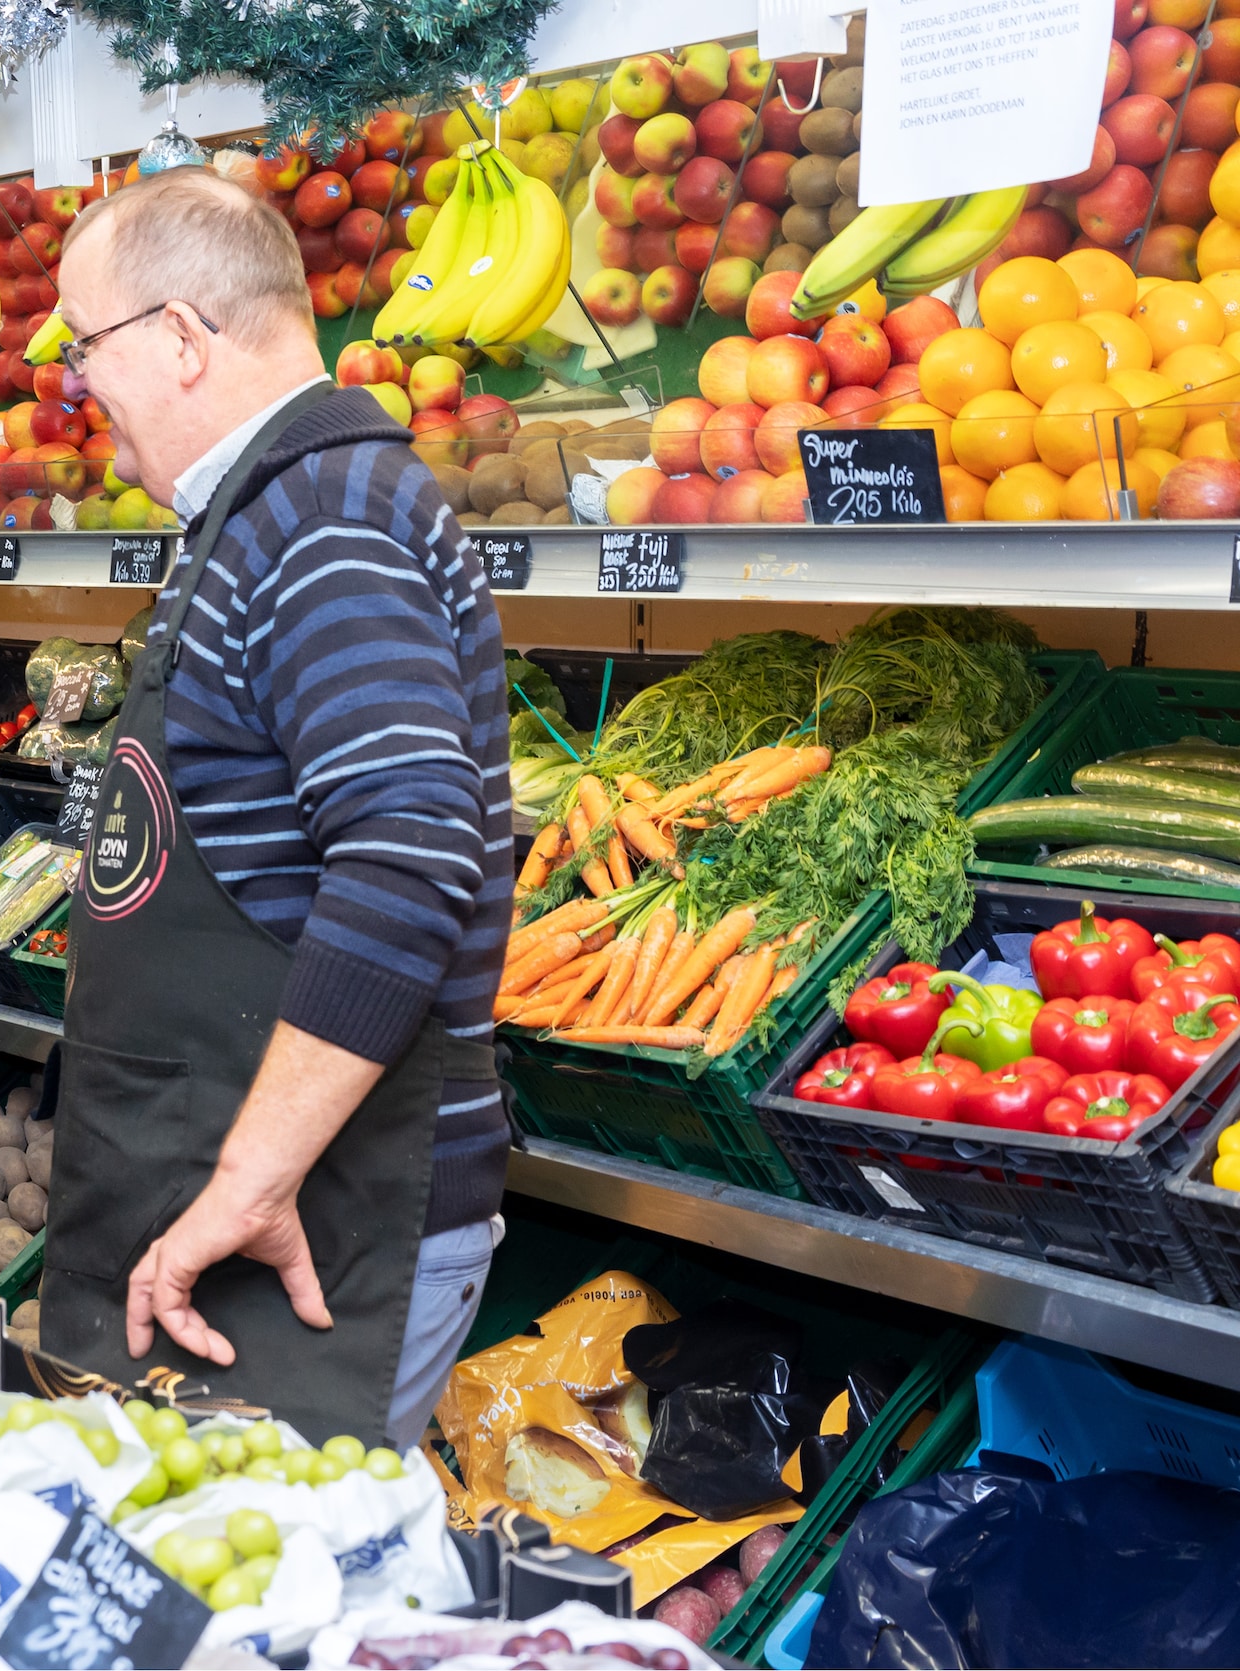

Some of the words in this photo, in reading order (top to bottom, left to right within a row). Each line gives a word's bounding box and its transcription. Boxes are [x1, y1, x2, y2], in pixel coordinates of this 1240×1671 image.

[900, 14, 946, 34] ZATERDAG
[947, 12, 959, 24] 30
[960, 3, 1009, 21] DECEMBER
[900, 32, 936, 51] LAATSTE
[986, 22, 995, 32] U
[998, 15, 1023, 30] BENT
[1025, 10, 1047, 23] VAN
[1047, 3, 1081, 19] HARTE
[900, 50, 941, 68] WELKOM
[942, 46, 959, 59] OM
[960, 41, 979, 55] VAN
[980, 35, 1007, 50] 16.00
[1009, 30, 1026, 44] TOT
[1029, 25, 1056, 41] 18.00
[1057, 21, 1081, 36] UUR
[900, 71, 918, 84] HET
[919, 66, 942, 81] GLAS
[943, 61, 964, 76] MET
[964, 57, 984, 72] ONS
[985, 54, 997, 67] TE
[899, 115, 925, 130] JOHN
[926, 113, 939, 126] EN
[940, 107, 966, 122] KARIN
[968, 97, 1025, 117] DOODEMAN
[803, 433, 859, 468] Super
[891, 488, 922, 515] Kilo
[97, 838, 128, 858] JOYN
